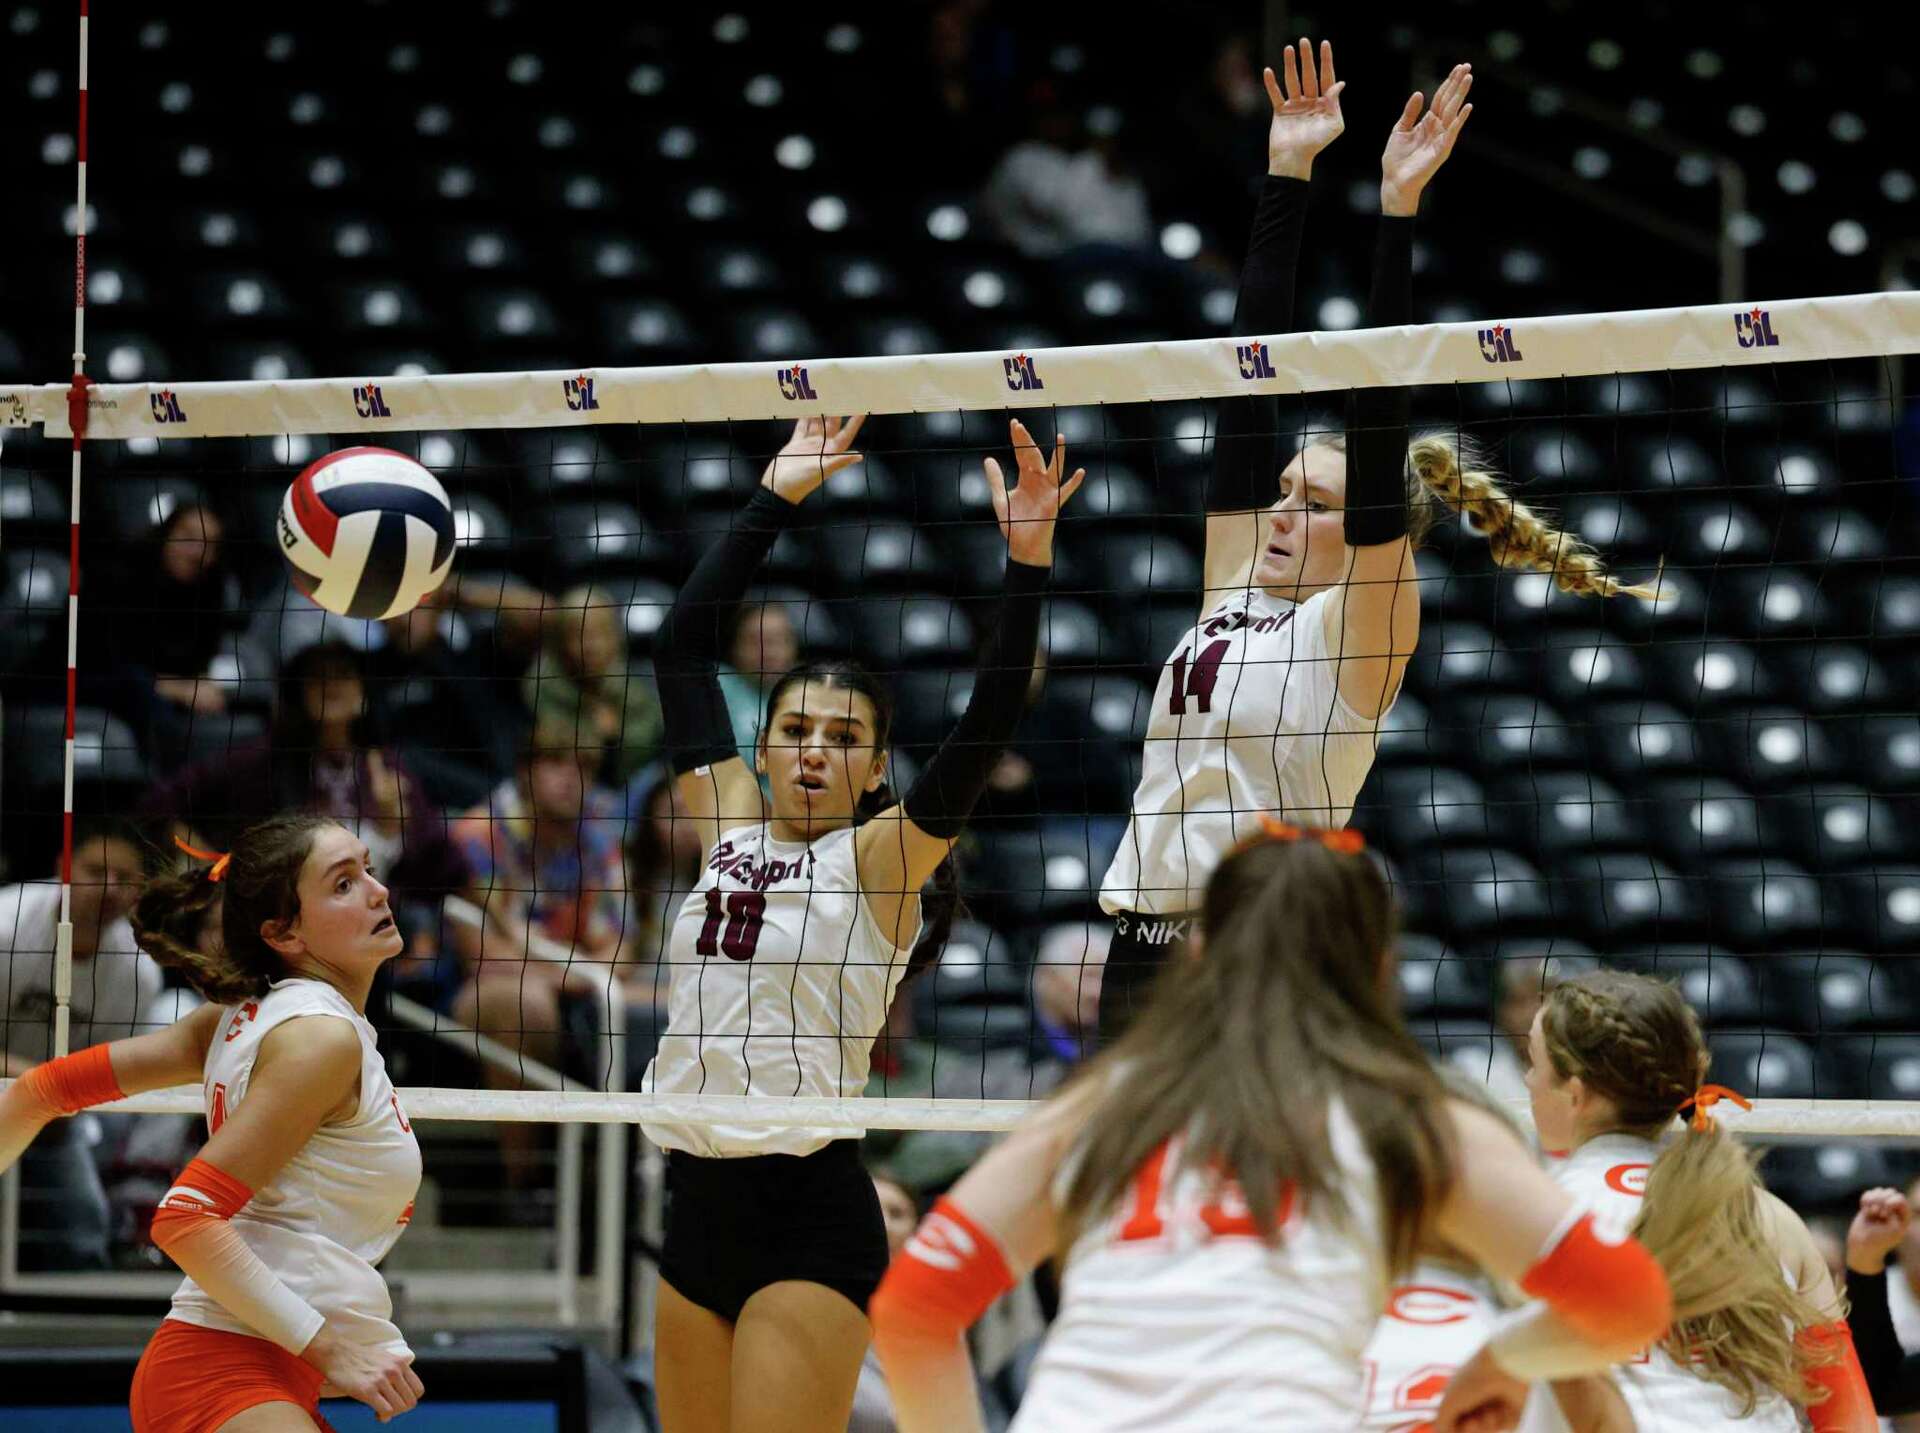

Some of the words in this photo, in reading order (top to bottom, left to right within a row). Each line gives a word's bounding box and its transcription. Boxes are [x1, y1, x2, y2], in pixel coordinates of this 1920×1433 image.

[1477, 323, 1523, 362] UIL
[1734, 307, 1779, 348] UIL
[1003, 353, 1044, 390] UIL
[1236, 340, 1277, 379] UIL
[353, 382, 392, 417] UIL
[563, 374, 600, 410] UIL
[777, 364, 818, 400] UIL
[151, 388, 188, 423] UIL
[1169, 639, 1231, 715] 14
[696, 887, 766, 961] 10
[1136, 919, 1188, 944] NIK
